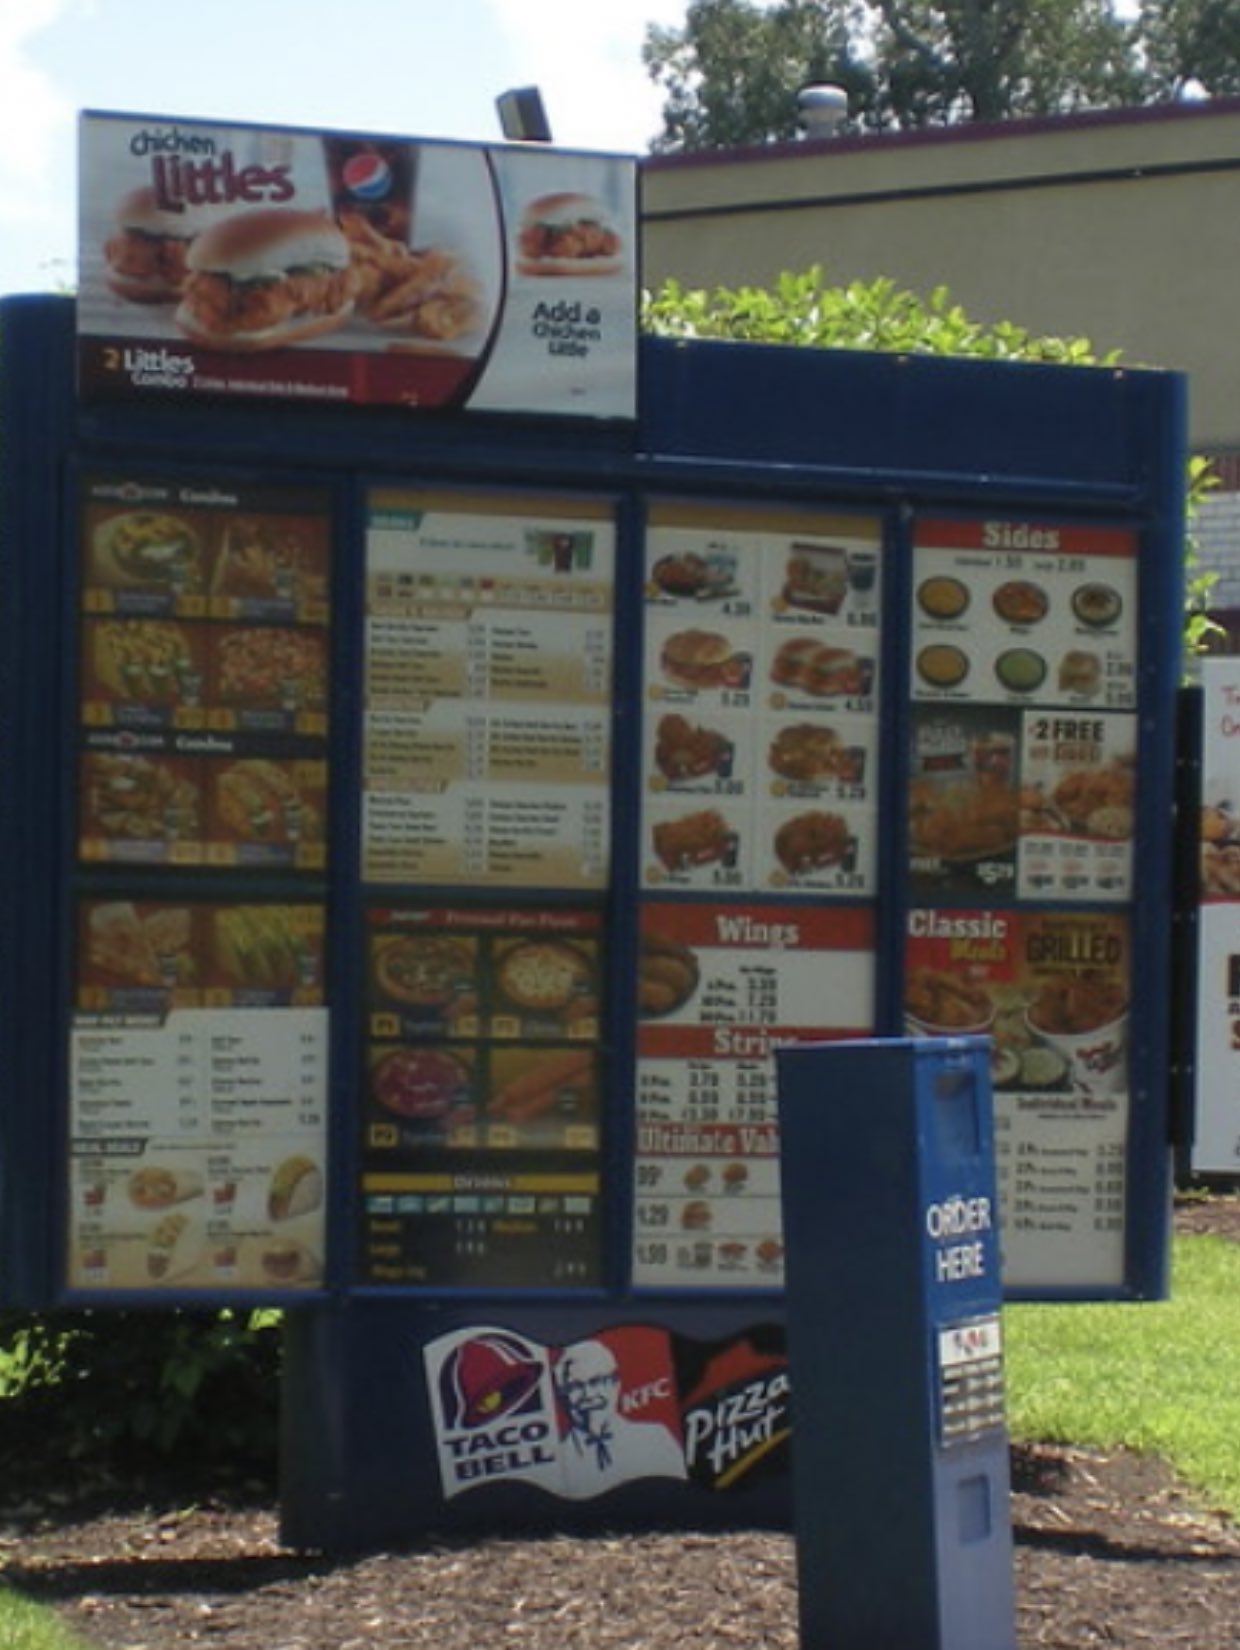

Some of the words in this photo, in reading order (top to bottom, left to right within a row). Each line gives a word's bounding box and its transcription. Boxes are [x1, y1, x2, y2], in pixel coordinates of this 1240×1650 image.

[531, 299, 581, 322] Add
[585, 307, 602, 325] a
[532, 321, 602, 341] Chicken
[122, 347, 195, 374] Littles
[547, 341, 590, 357] Little
[130, 370, 188, 388] Combo
[982, 521, 1061, 549] Sides
[1052, 719, 1104, 742] FREE
[716, 915, 800, 950] Wings
[908, 909, 1008, 938] Classic
[1026, 932, 1121, 964] GRILLED
[637, 1125, 738, 1153] Ultimate
[926, 1196, 992, 1238] ORDER
[934, 1242, 986, 1283] HERE
[621, 1378, 671, 1413] KFC
[686, 1373, 791, 1466] Pizza
[443, 1422, 550, 1456] TACO
[709, 1405, 786, 1473] Hut
[454, 1444, 555, 1481] BELL
